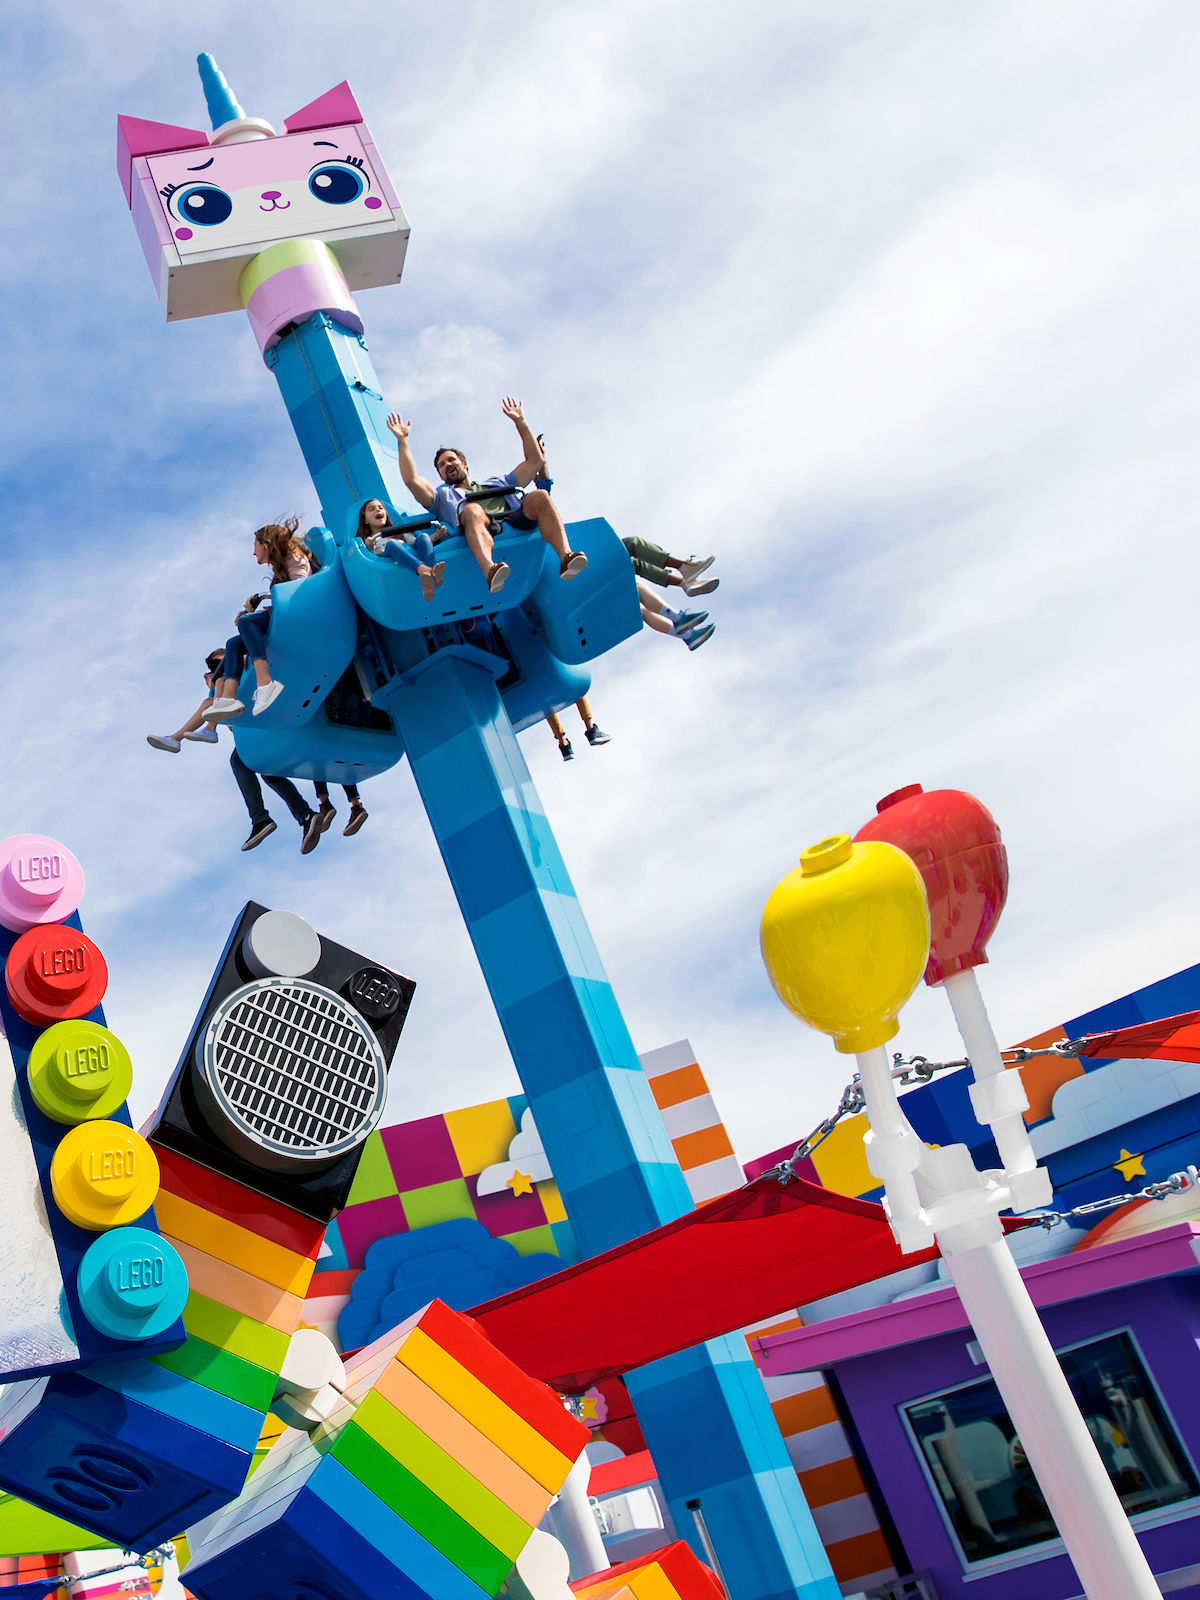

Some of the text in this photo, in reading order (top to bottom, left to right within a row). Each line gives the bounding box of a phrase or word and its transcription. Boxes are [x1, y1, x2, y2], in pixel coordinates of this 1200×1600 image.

[19, 856, 61, 880] LEGO
[41, 946, 85, 975] LEGO
[355, 974, 399, 1008] LEGO
[65, 1044, 109, 1077] LEGO
[89, 1150, 135, 1181] LEGO
[117, 1256, 164, 1290] LEGO
